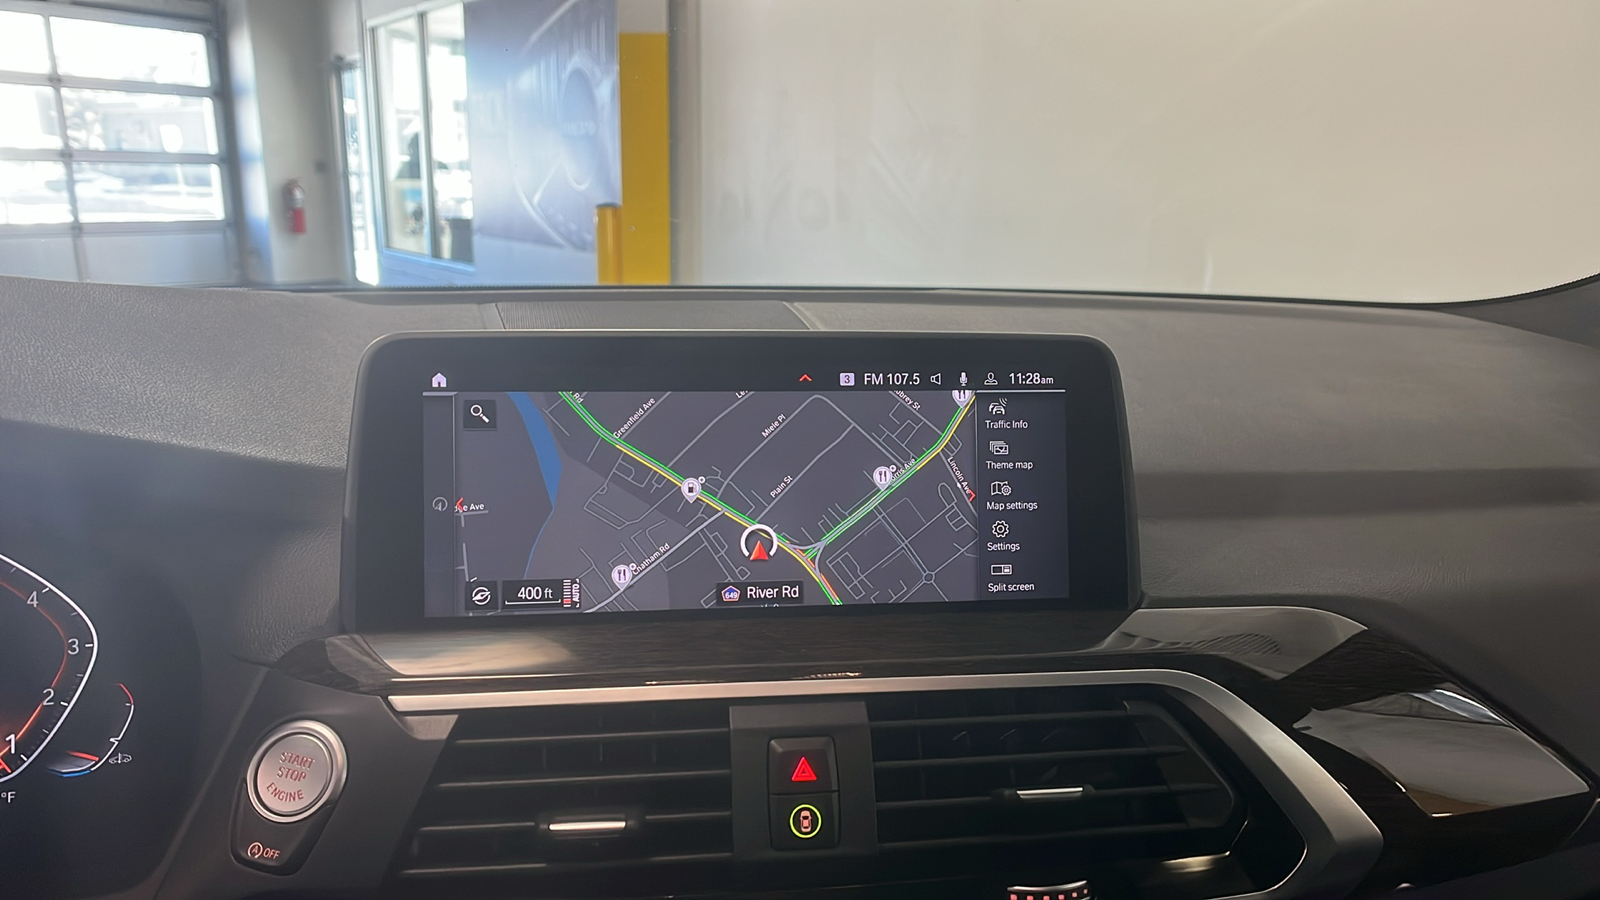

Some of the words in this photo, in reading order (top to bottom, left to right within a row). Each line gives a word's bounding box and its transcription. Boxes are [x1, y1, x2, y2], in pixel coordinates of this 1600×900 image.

[864, 373, 883, 385] FM
[887, 373, 920, 385] 107.5
[1009, 372, 1054, 385] 11:28am
[573, 392, 584, 404] Rd
[735, 390, 749, 399] Le
[893, 390, 913, 405] ubrey
[912, 401, 921, 411] St
[613, 408, 644, 439] Greenfield
[642, 398, 656, 411] Ave
[761, 421, 780, 438] Miele
[777, 413, 786, 423] Pl
[985, 419, 1011, 429] Traffic
[1012, 419, 1028, 429] Info
[903, 458, 916, 470] Ave
[985, 460, 1014, 469] Theme
[1015, 461, 1034, 471] map
[947, 456, 965, 482] Lincoln
[961, 481, 971, 495] Ave
[770, 482, 787, 498] Plain
[783, 475, 793, 486] St
[469, 503, 485, 511] Ave
[986, 501, 1005, 511] Map
[1006, 501, 1038, 511] settings
[659, 542, 671, 556] Rd
[987, 541, 1021, 552] Settings
[517, 586, 543, 600] 400
[544, 588, 553, 599] ft
[572, 583, 580, 602] AUTO
[724, 591, 738, 599] 649
[746, 586, 779, 599] River
[782, 584, 799, 598] Rd
[987, 583, 1007, 593] Split
[1007, 583, 1035, 592] screen
[26, 592, 39, 607] 4
[67, 638, 80, 655] 3
[42, 688, 55, 706] 2
[5, 733, 16, 754] 1
[279, 751, 315, 770] START
[276, 765, 307, 783] STOP
[265, 781, 305, 803] ENGINE
[263, 847, 281, 860] OFF
